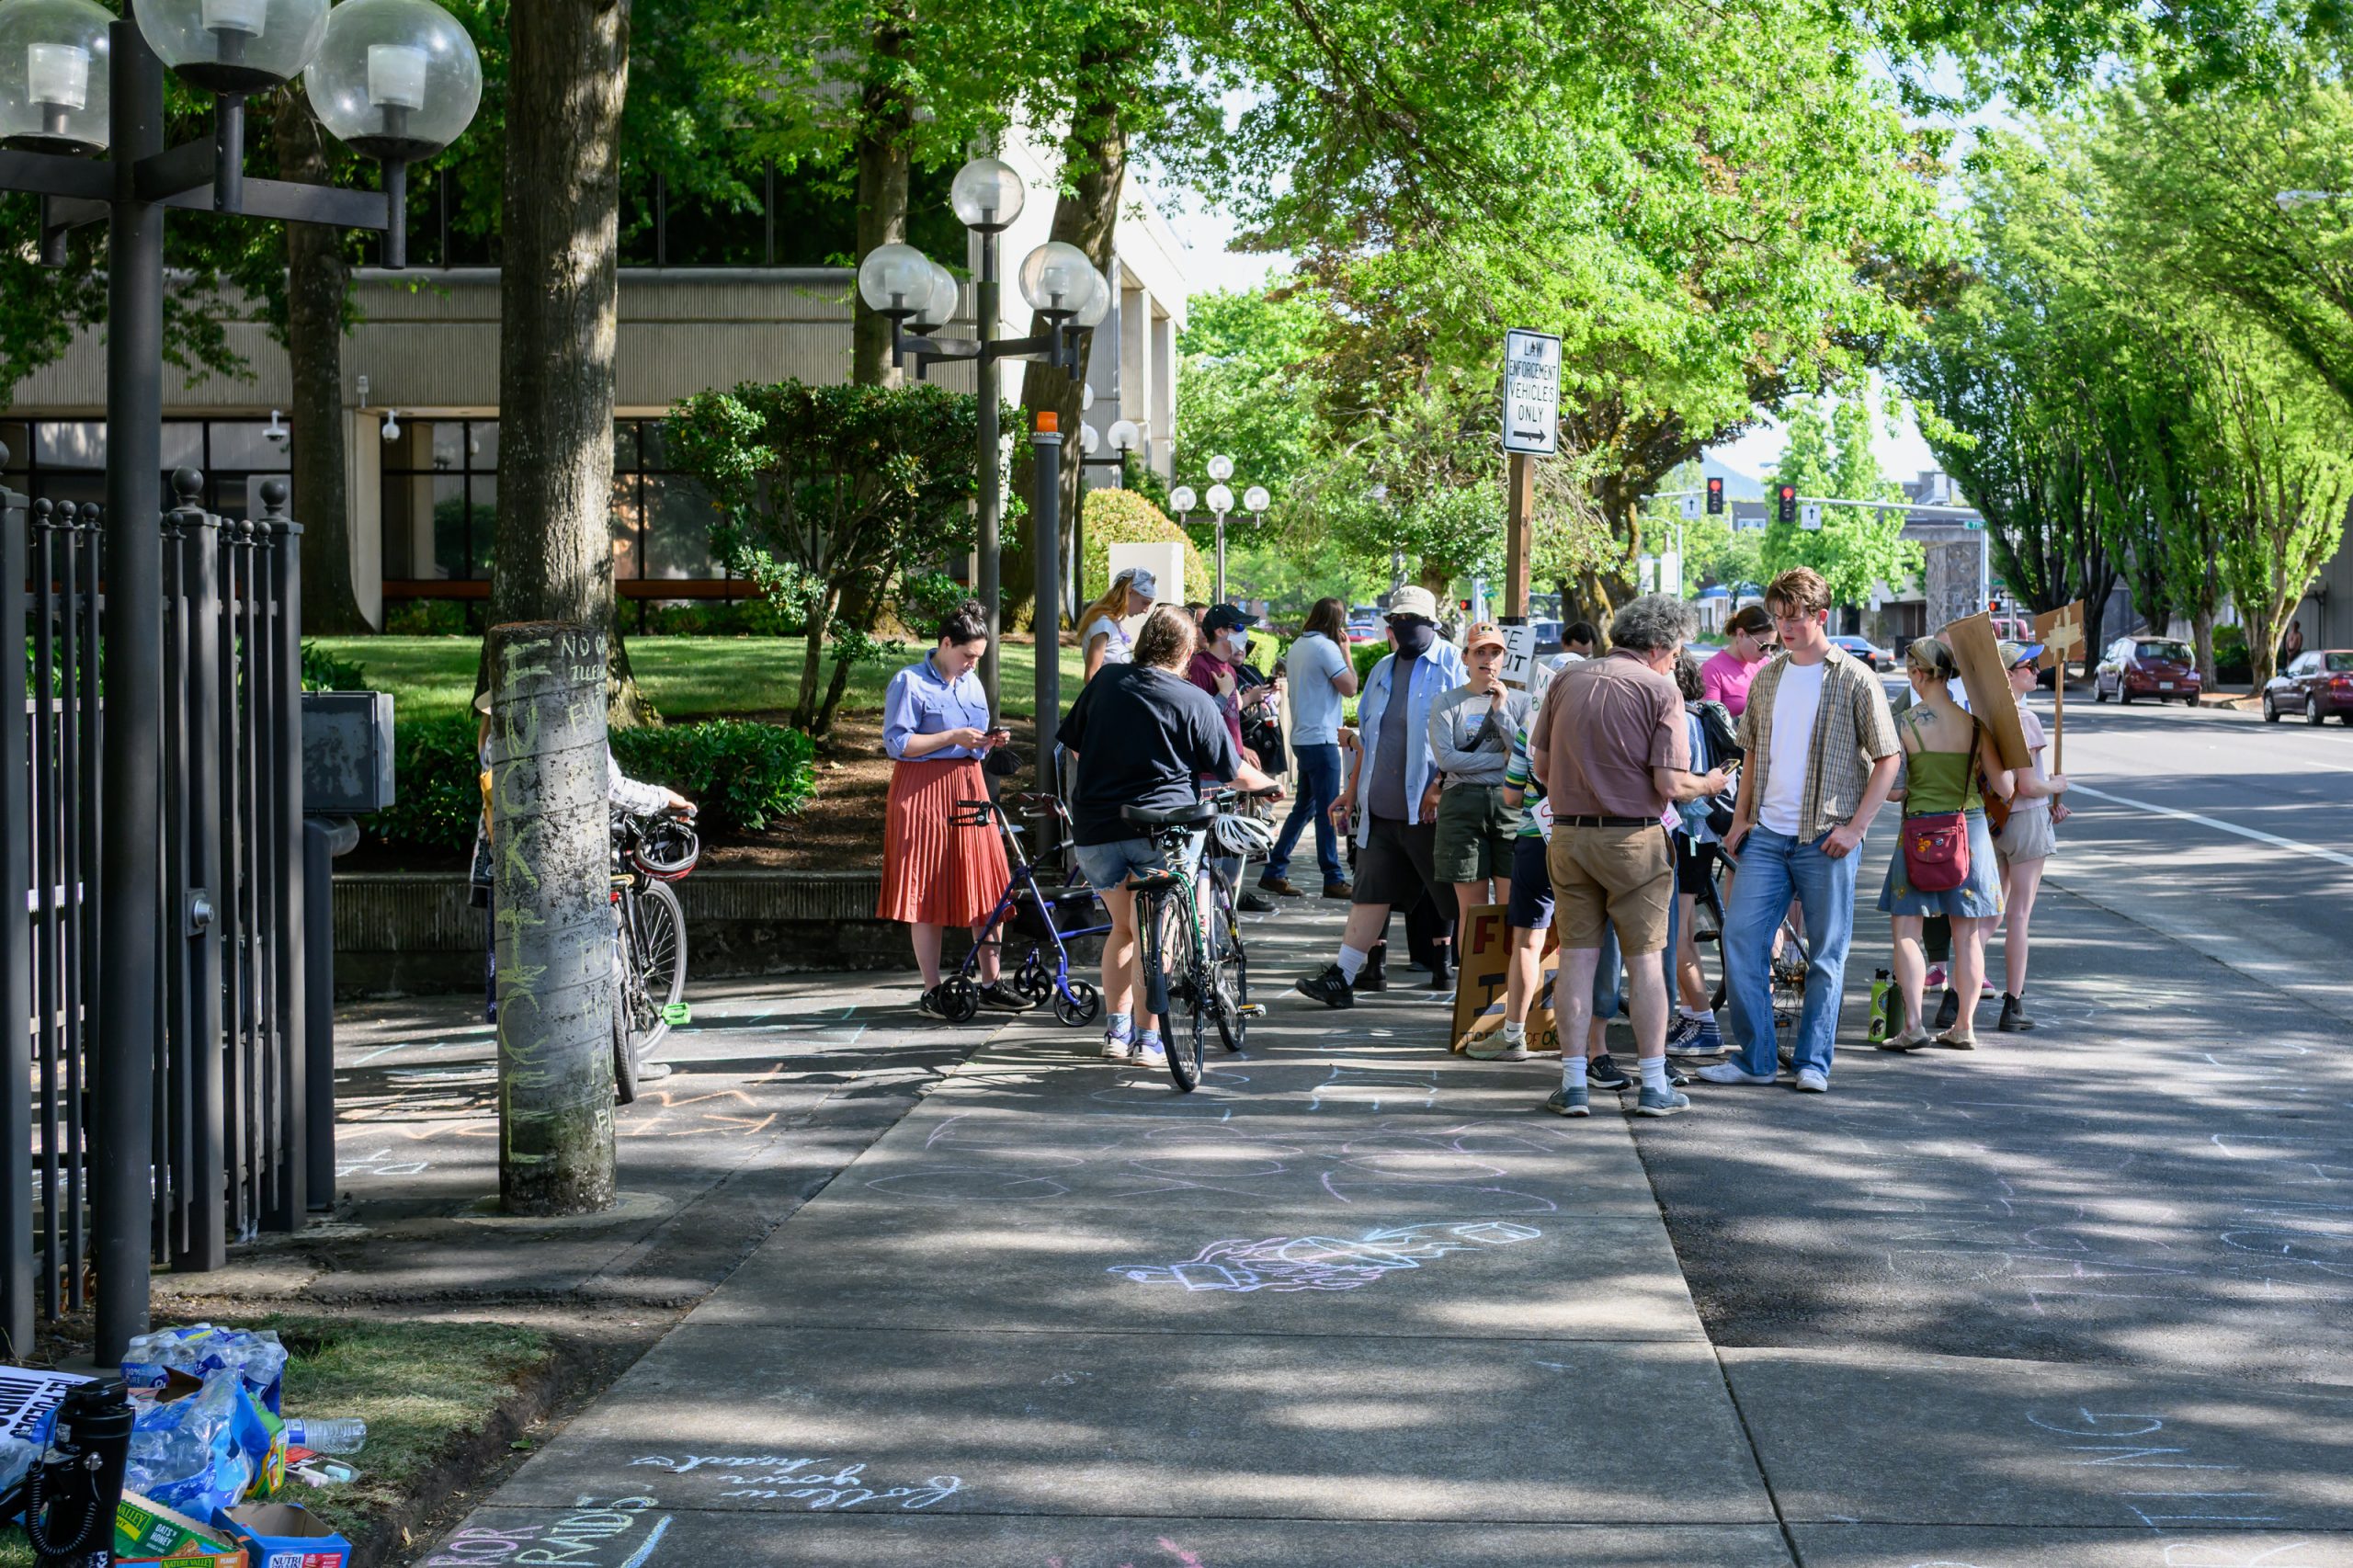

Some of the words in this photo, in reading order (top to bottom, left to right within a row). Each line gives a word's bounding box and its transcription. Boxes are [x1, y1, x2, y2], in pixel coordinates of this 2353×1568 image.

[1524, 339, 1544, 358] LAW
[1508, 359, 1556, 381] ENFORCEMENT
[1509, 381, 1554, 403] VEHICLES
[1518, 404, 1544, 423] ONLY
[155, 1523, 171, 1537] OATS
[150, 1532, 174, 1547] HONEY
[163, 1558, 189, 1568] NATURE
[189, 1557, 215, 1567] VALLEY
[272, 1556, 302, 1565] NUTRI
